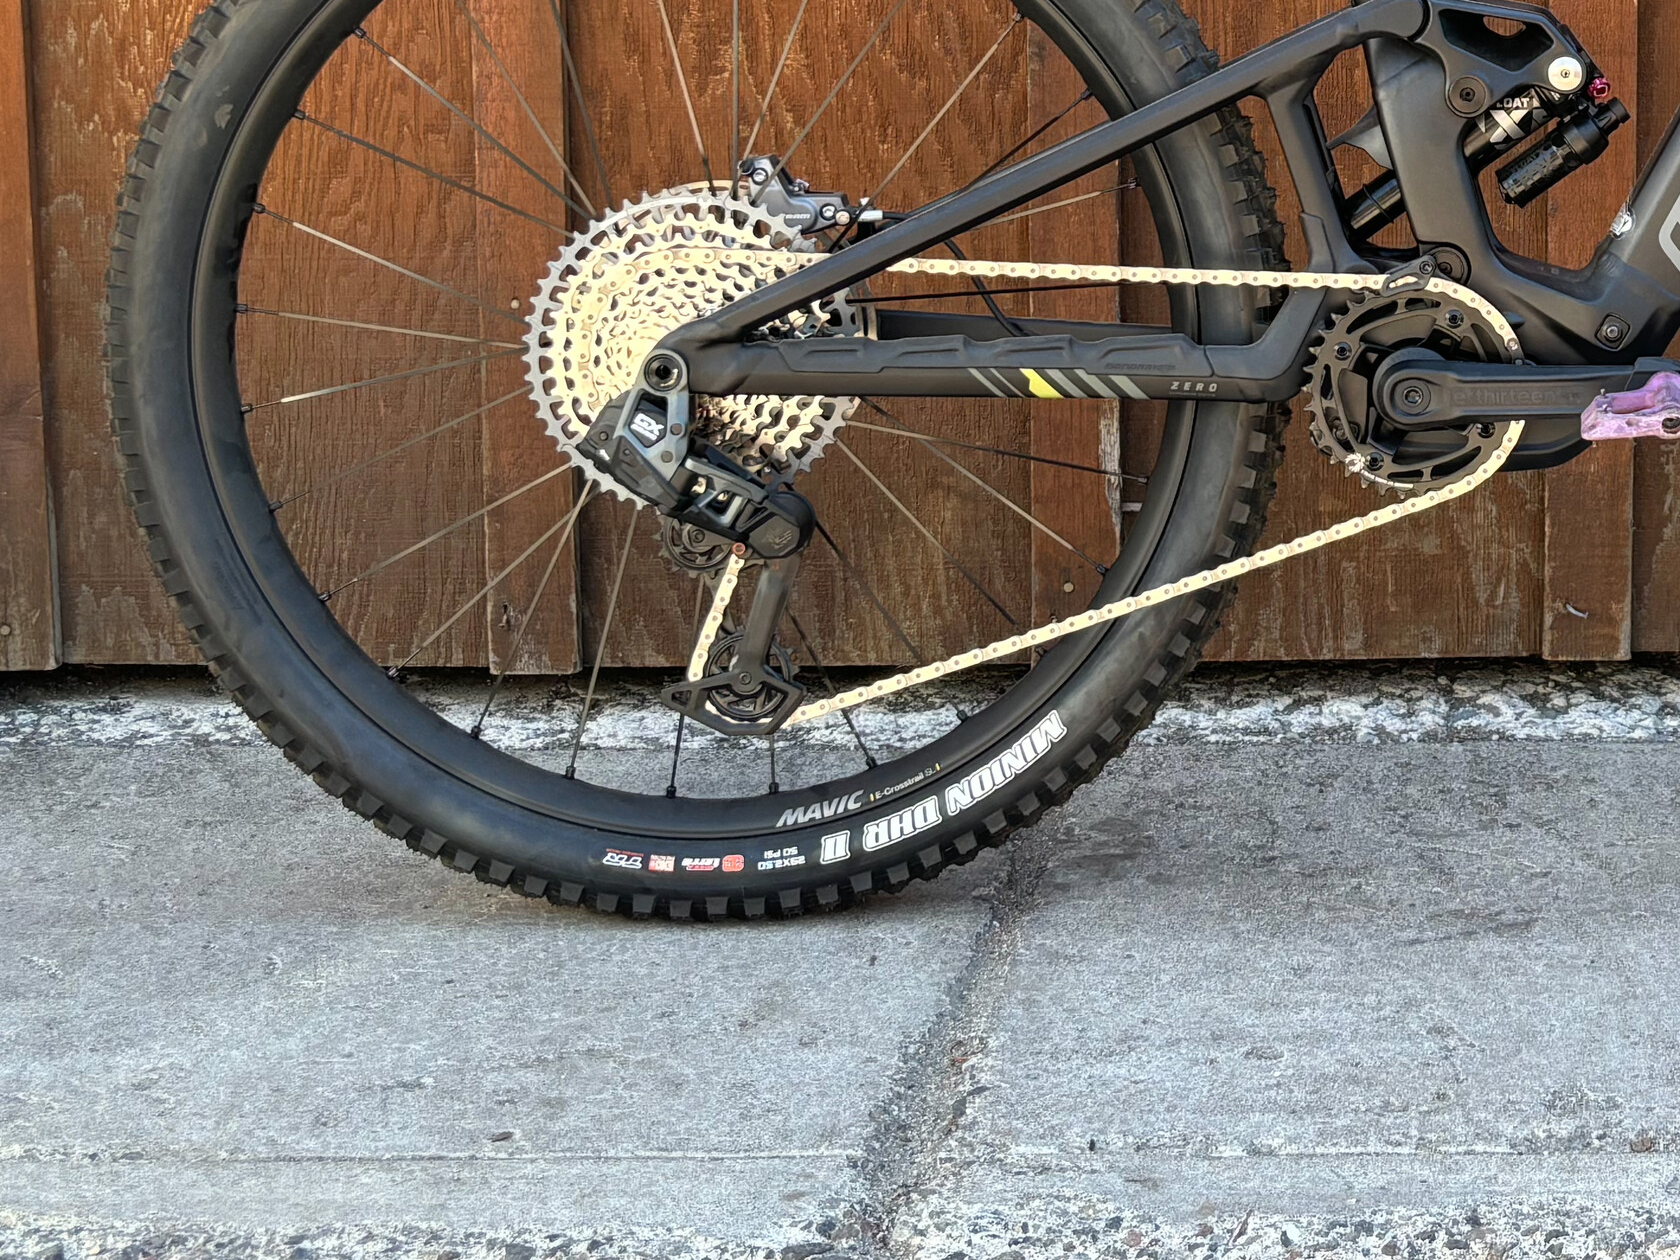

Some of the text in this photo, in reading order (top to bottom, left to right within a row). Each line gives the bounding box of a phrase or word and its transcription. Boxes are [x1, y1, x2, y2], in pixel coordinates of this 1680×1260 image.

[1170, 381, 1218, 392] ZERO
[945, 709, 1068, 817] MINION
[775, 790, 864, 828] MAVIC
[862, 795, 943, 853] DHR
[763, 848, 781, 860] PSI
